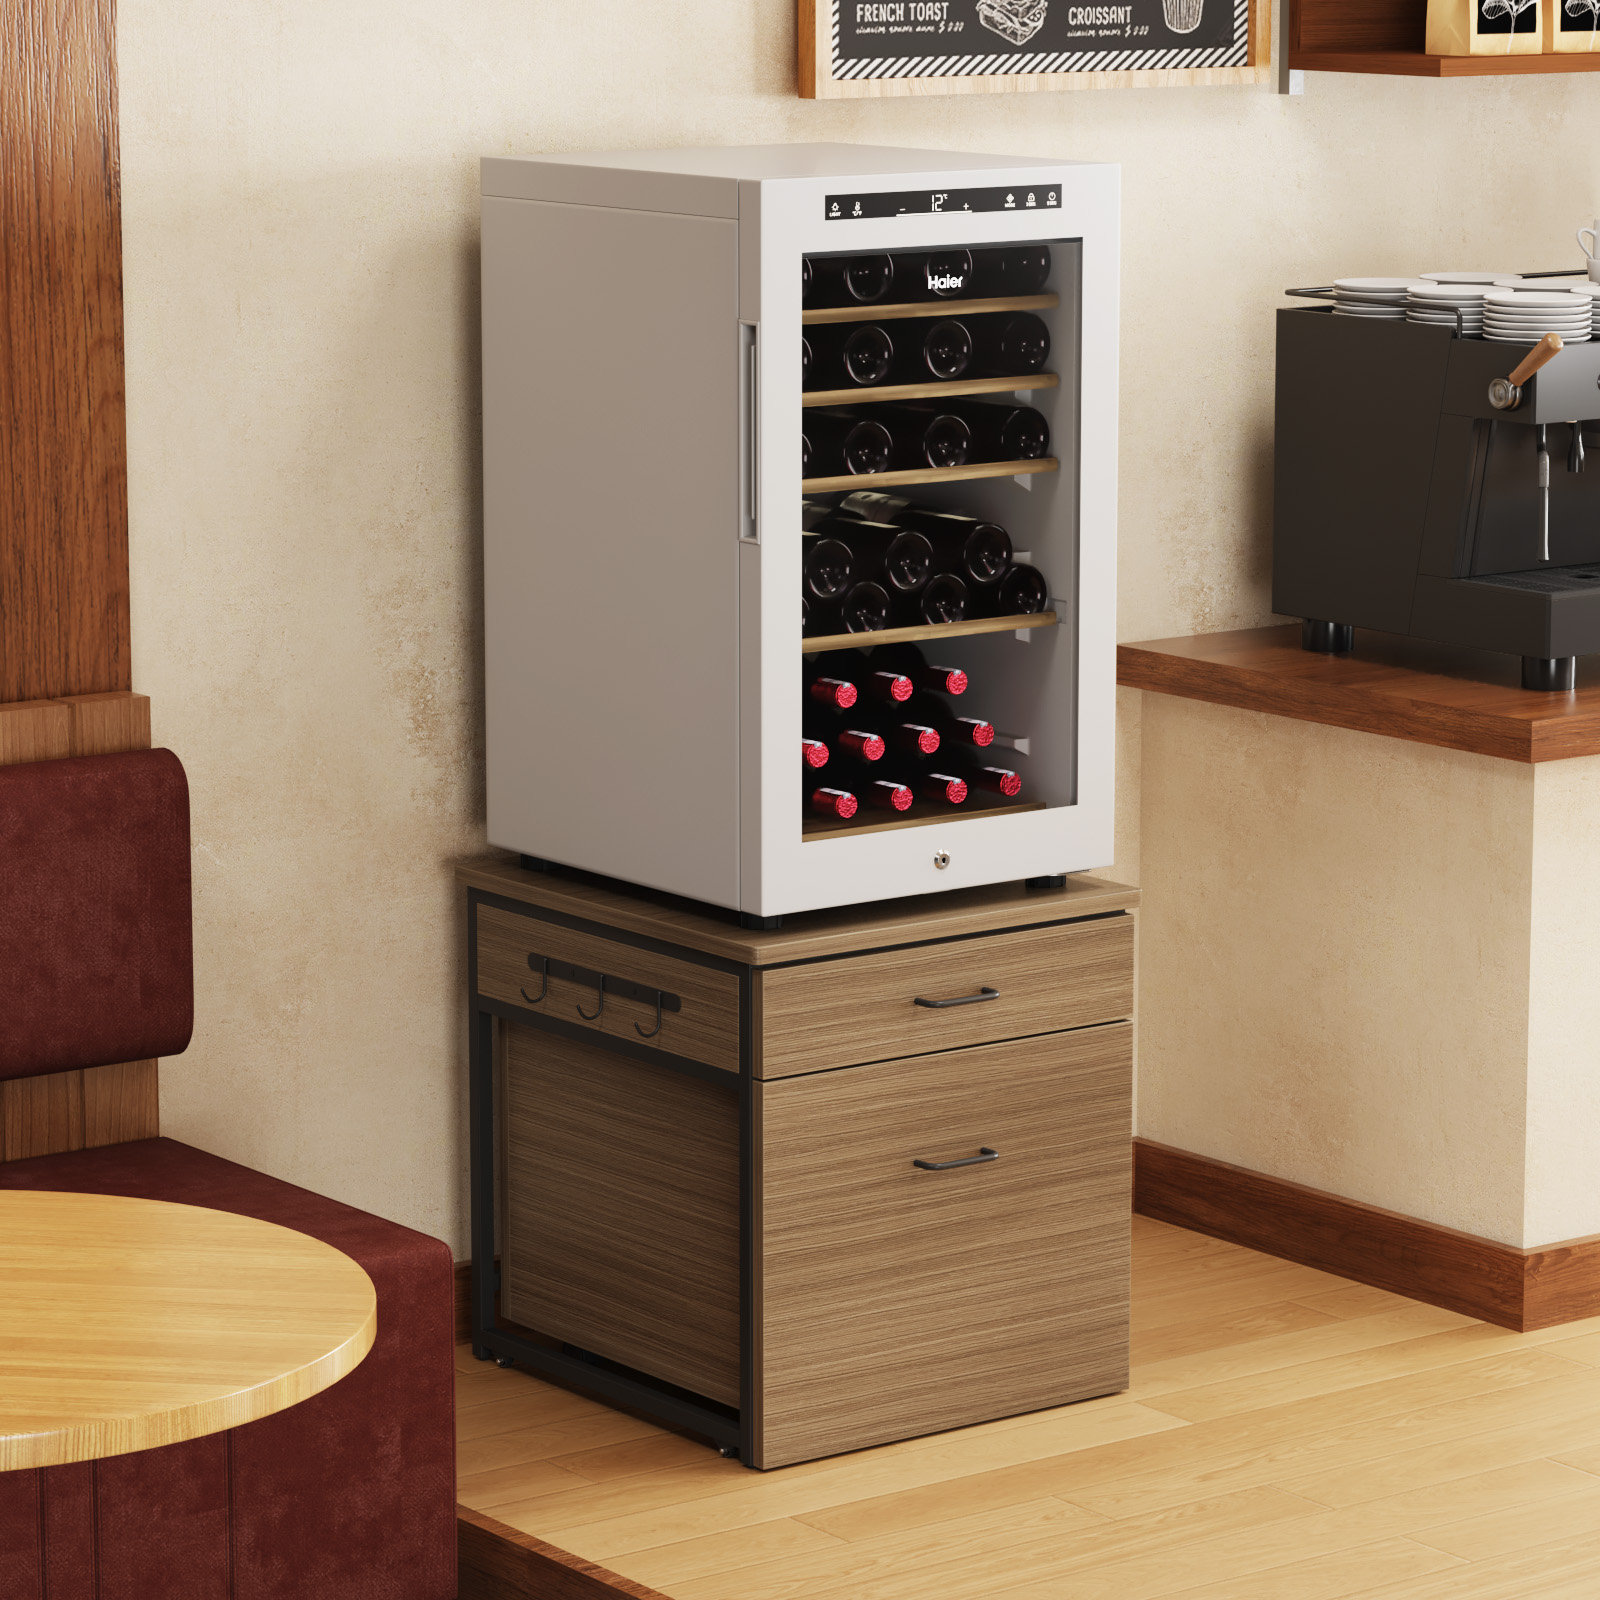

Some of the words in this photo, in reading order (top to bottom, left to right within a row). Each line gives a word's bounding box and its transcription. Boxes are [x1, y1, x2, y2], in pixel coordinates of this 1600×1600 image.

[856, 3, 905, 22] FRENCH
[908, 2, 949, 21] TOAST
[1068, 6, 1132, 26] CROISSANT
[927, 273, 964, 290] Haier
